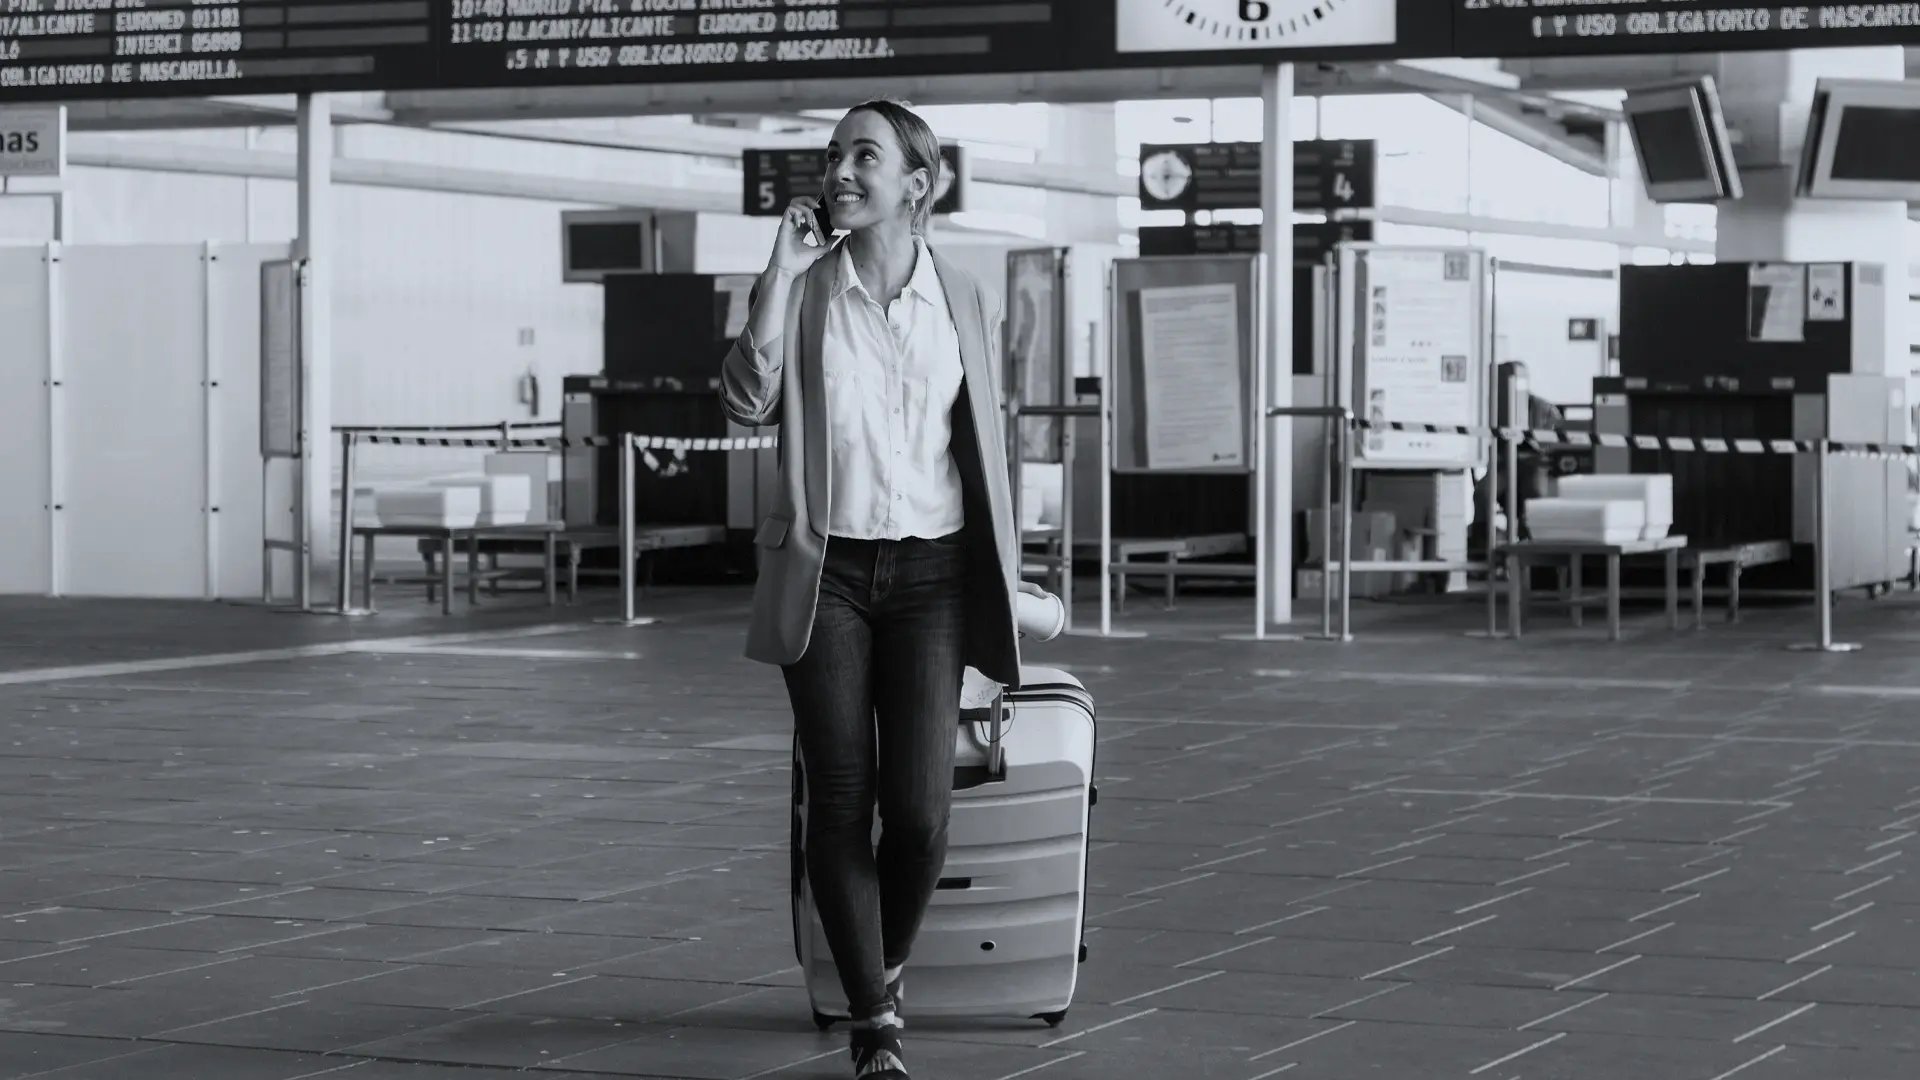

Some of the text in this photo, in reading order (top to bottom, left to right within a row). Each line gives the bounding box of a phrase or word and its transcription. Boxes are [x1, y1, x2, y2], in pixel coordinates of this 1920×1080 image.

[451, 22, 504, 43] 11:03
[1575, 13, 1617, 36] USO
[1625, 9, 1770, 34] OBLIGATORIO
[1779, 6, 1809, 30] DE
[575, 46, 612, 67] USO
[744, 41, 770, 62] DE
[111, 62, 133, 82] DE
[759, 182, 776, 208] 5
[1333, 172, 1355, 201] 4
